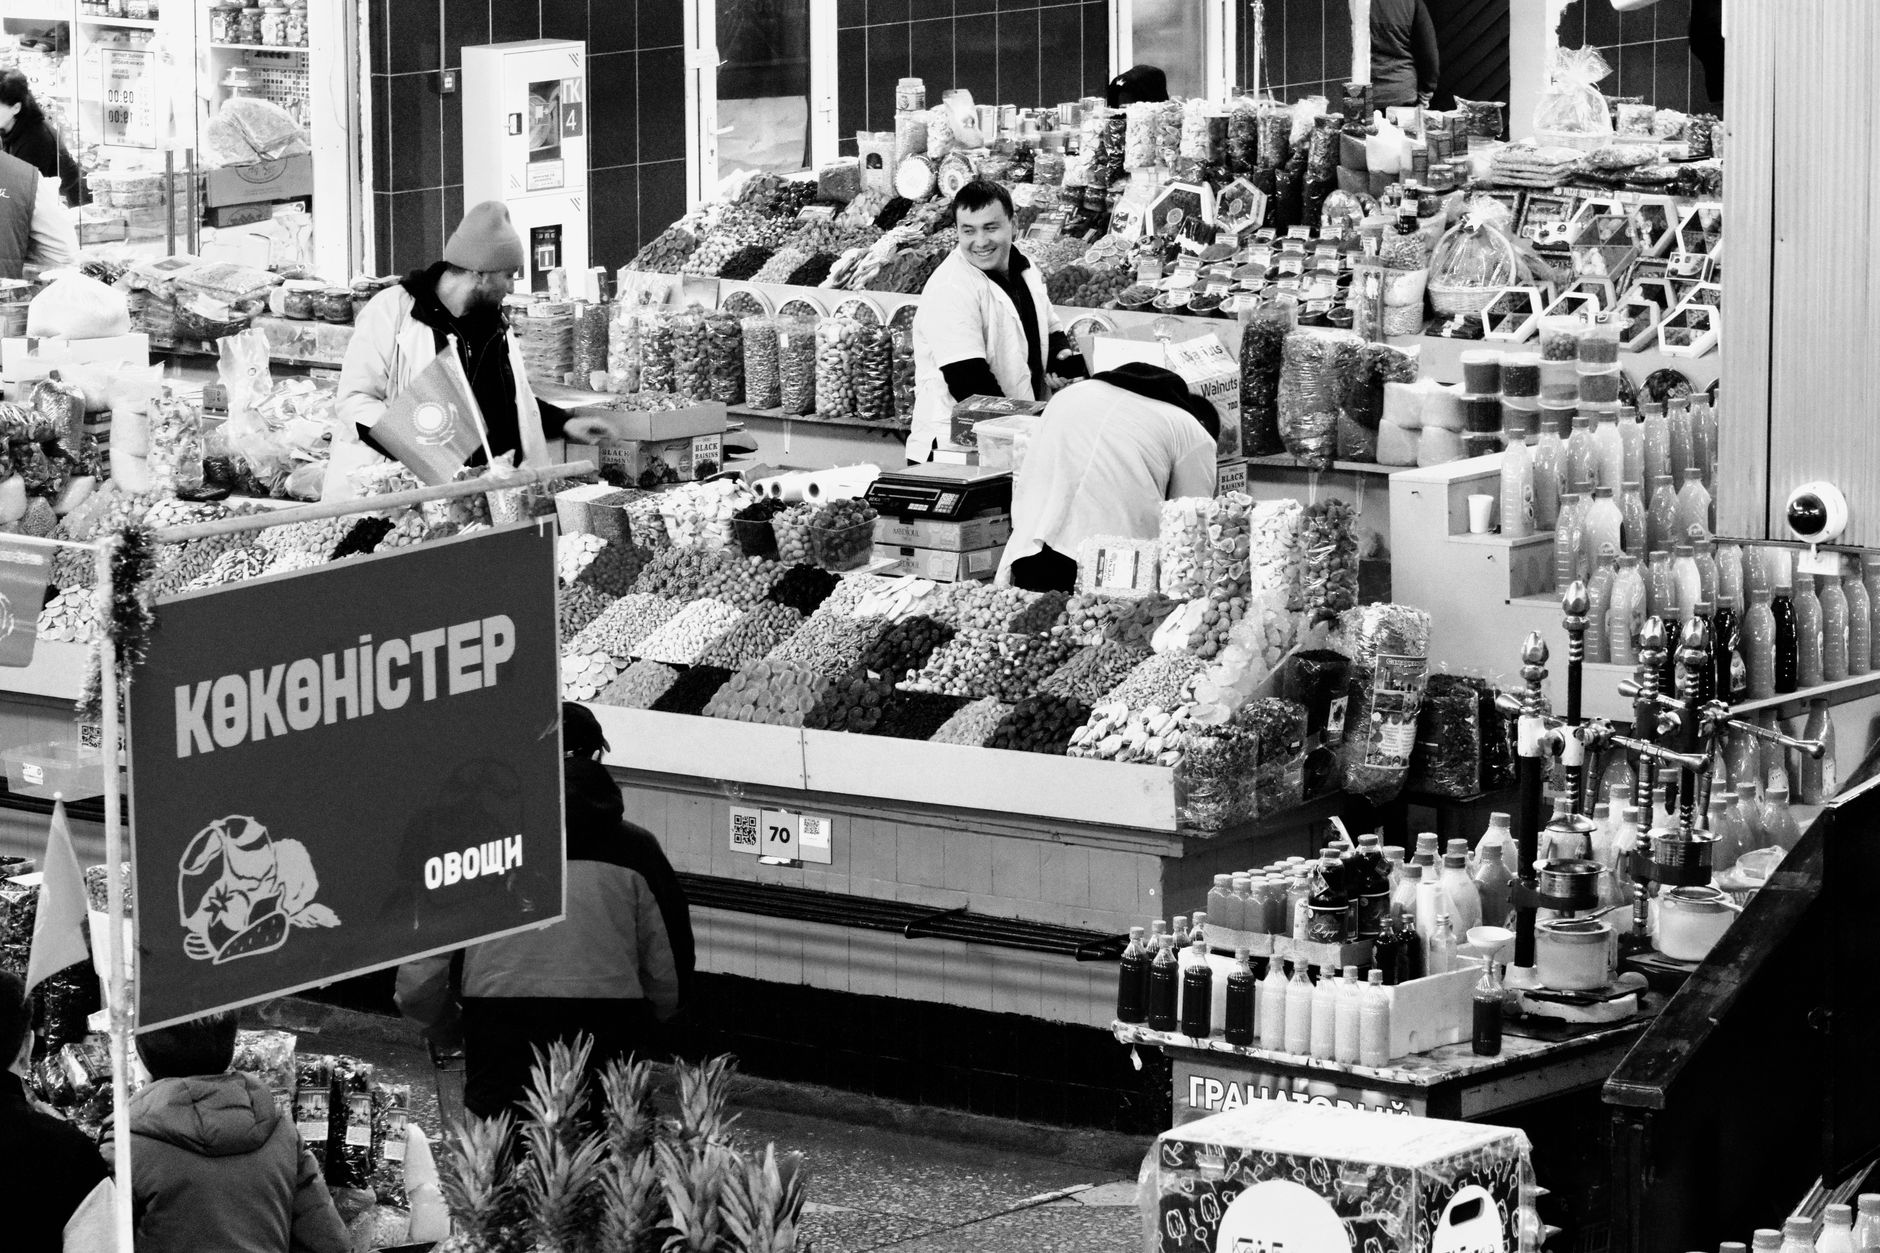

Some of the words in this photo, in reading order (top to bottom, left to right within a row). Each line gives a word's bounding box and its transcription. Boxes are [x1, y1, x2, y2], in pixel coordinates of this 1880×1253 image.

[563, 79, 581, 103] ПК
[566, 109, 577, 131] 4
[1201, 378, 1238, 398] Walnuts
[601, 449, 630, 457] BLACK
[695, 443, 718, 452] BLACK
[695, 452, 719, 460] RAISINS
[1221, 473, 1244, 482] BLACK
[769, 826, 790, 843] 70
[424, 834, 523, 890] ОВОЩИ
